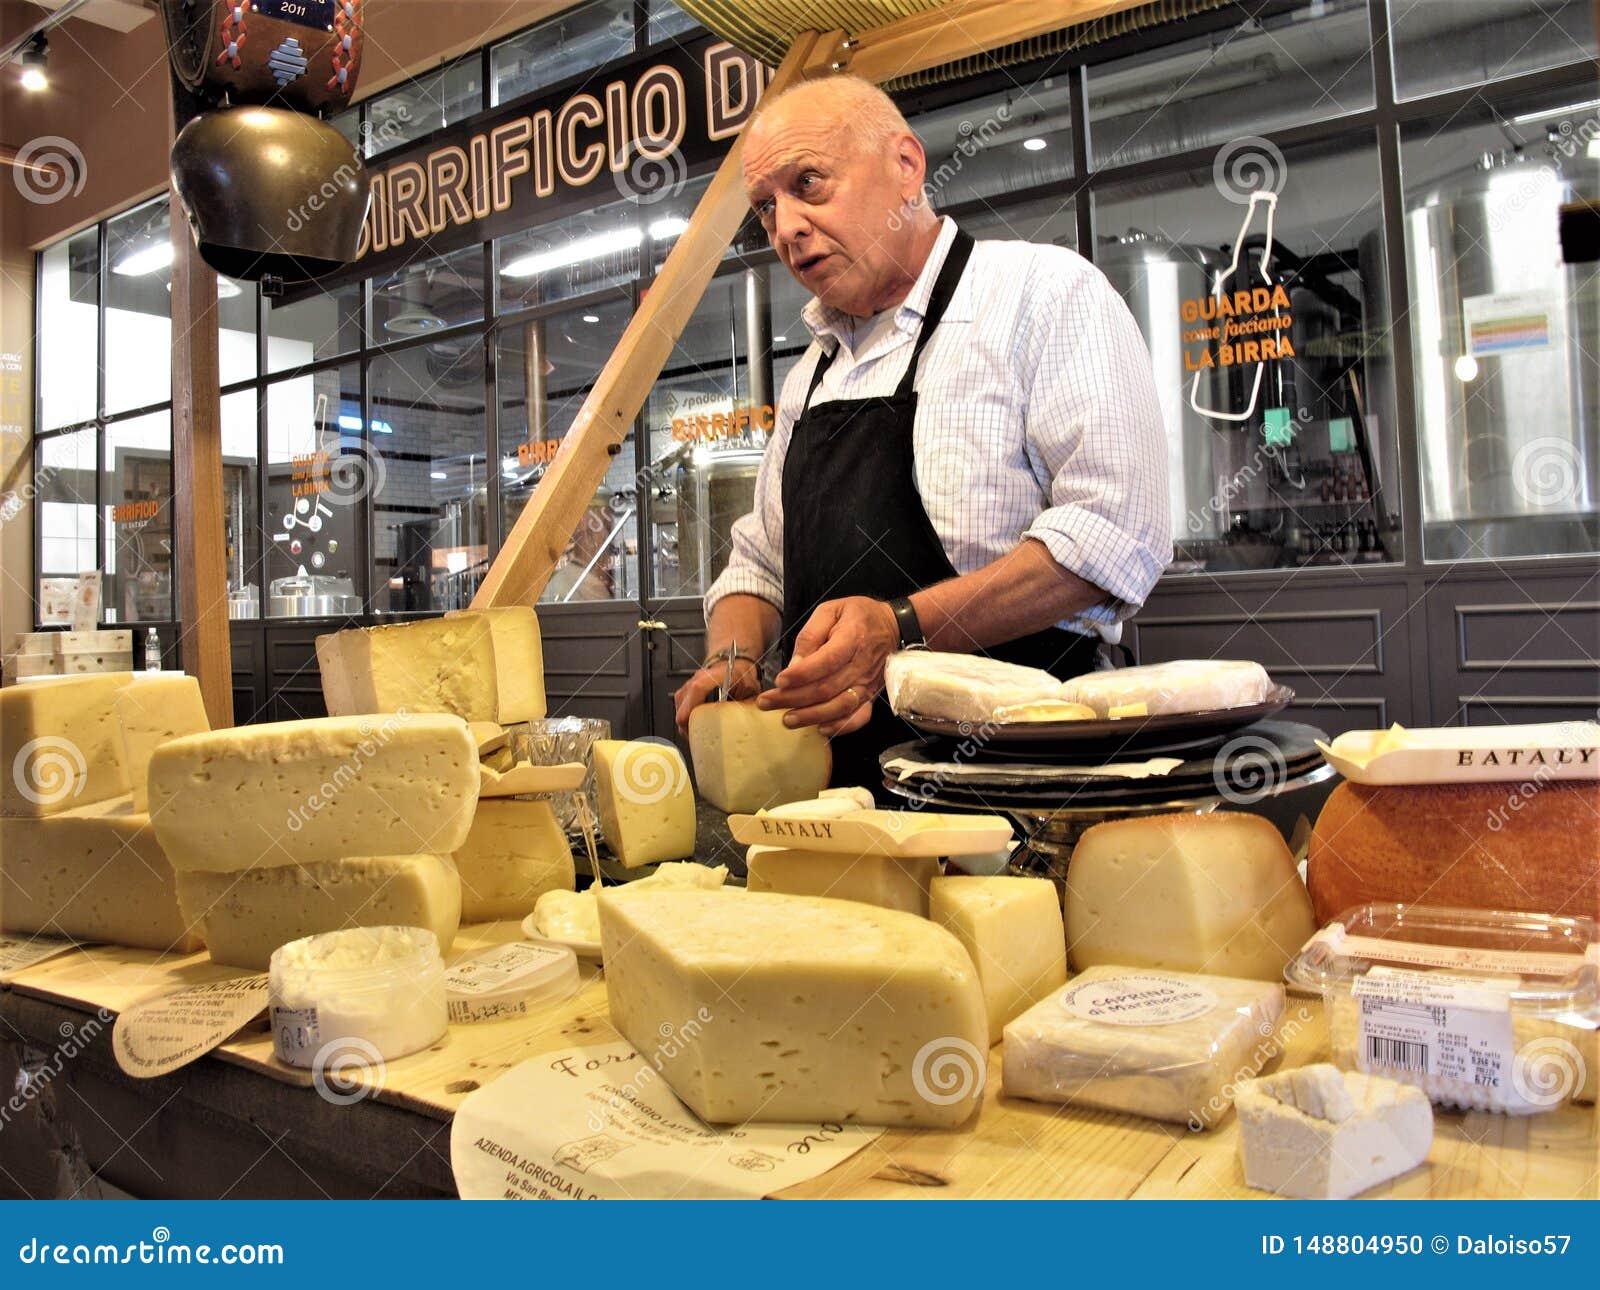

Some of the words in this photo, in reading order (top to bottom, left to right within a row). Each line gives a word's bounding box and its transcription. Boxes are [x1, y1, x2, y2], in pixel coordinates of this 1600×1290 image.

[281, 1, 306, 17] 2011
[1182, 284, 1291, 322] GUARDA
[1183, 327, 1220, 344] come
[1221, 314, 1293, 344] facciamo
[1184, 348, 1215, 371] LA
[1219, 335, 1296, 366] BIRRA
[112, 501, 160, 522] BIRRIFICIO
[1457, 748, 1595, 767] EATALY
[761, 819, 833, 838] EATALY
[1092, 988, 1175, 1007] CAPRINO
[474, 1137, 519, 1167] AZIENDA
[517, 1160, 573, 1197] AGRICOLA
[505, 1171, 520, 1187] Via
[520, 1179, 539, 1197] San
